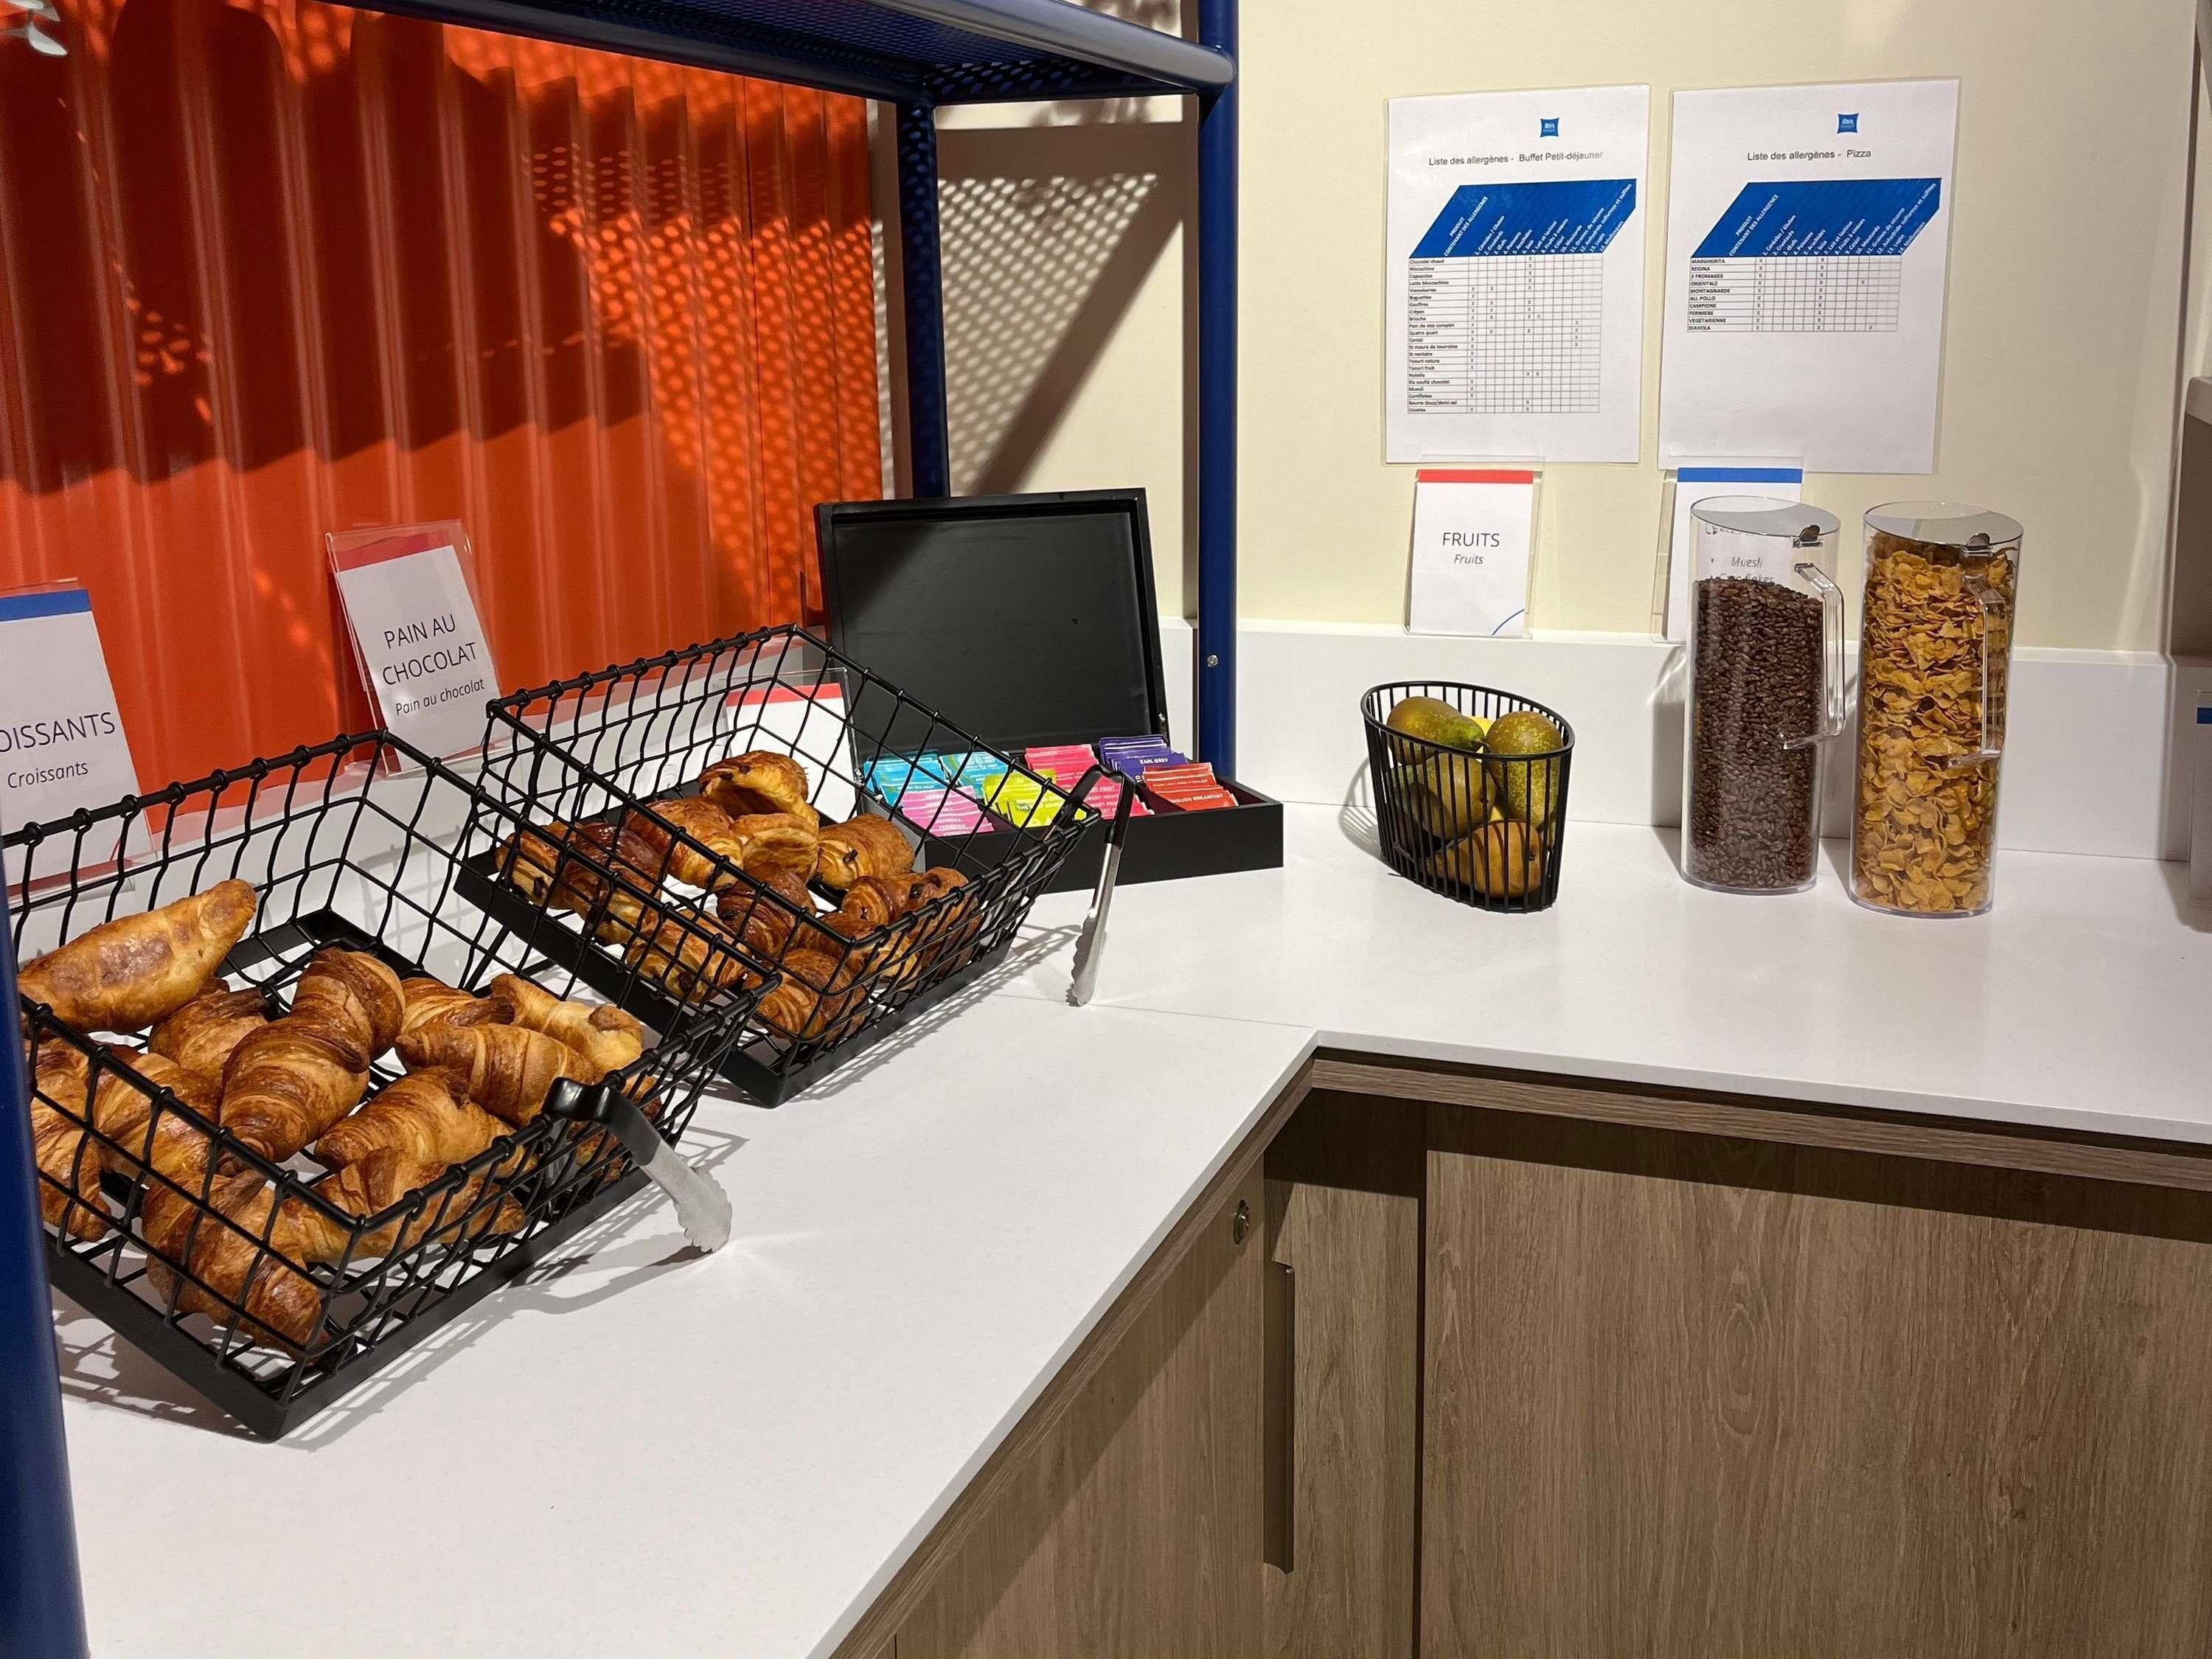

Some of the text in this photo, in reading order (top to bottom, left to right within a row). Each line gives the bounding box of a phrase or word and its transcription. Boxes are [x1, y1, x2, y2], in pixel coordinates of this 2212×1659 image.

[1429, 158, 1447, 166] Liste
[1519, 153, 1543, 162] Buffet
[1545, 151, 1603, 161] Petit-déjeuner
[1747, 152, 1767, 161] Liste
[1770, 152, 1787, 160] des
[1846, 150, 1871, 158] Pizza
[1442, 532, 1500, 547] FRUITS
[1454, 554, 1484, 564] Fruits
[1731, 557, 1762, 567] Muesli
[383, 613, 456, 649] PAIN AU
[383, 641, 477, 685] CHOCOLAT
[395, 678, 484, 716] Pain au chocolat
[8, 762, 88, 788] Croissants
